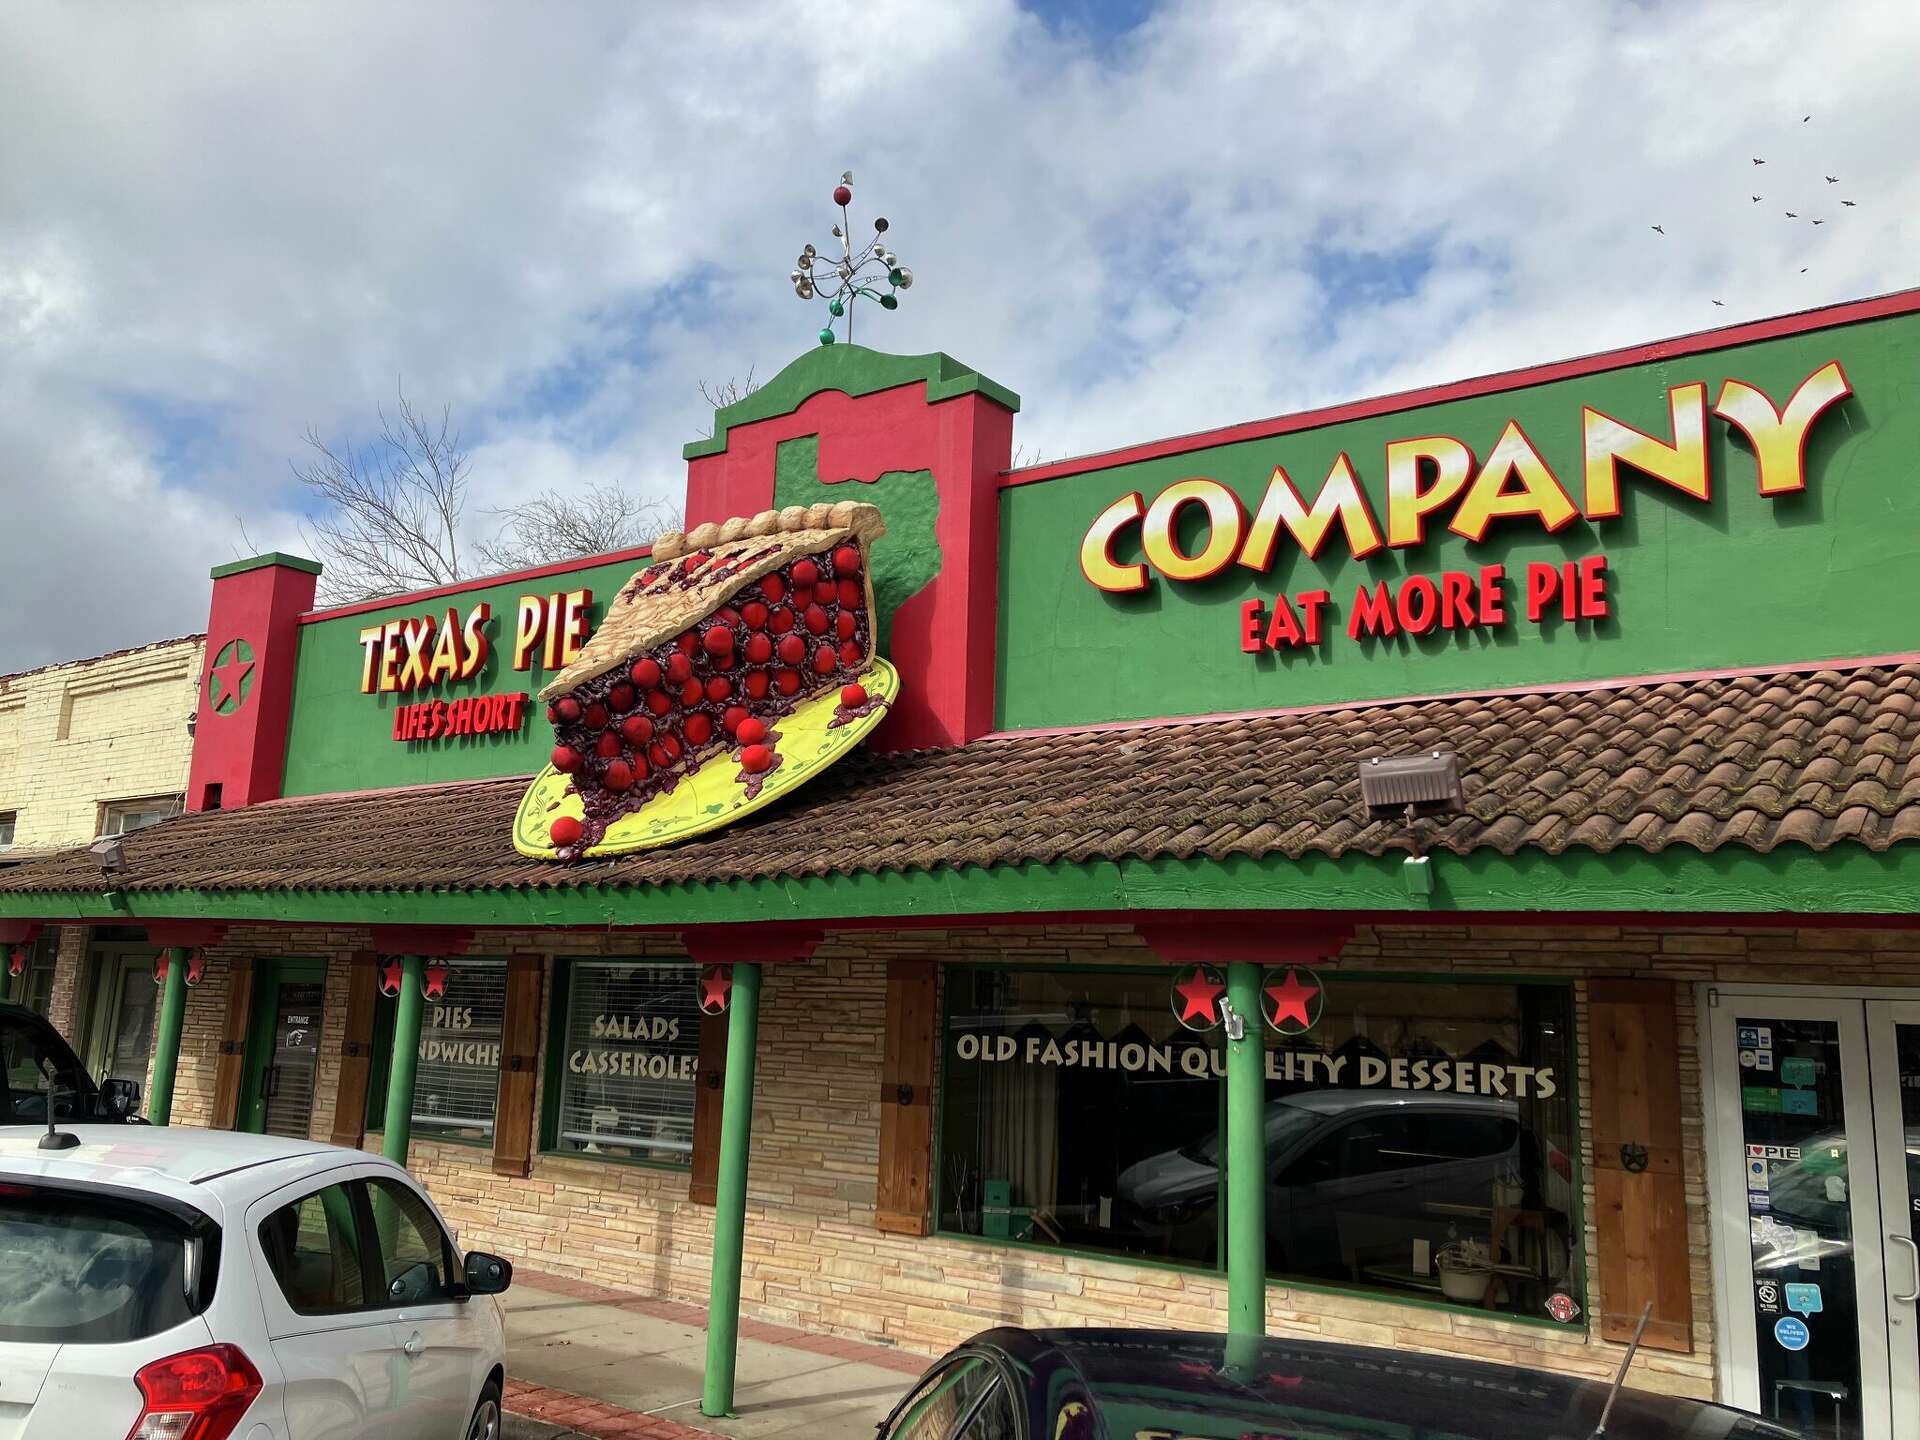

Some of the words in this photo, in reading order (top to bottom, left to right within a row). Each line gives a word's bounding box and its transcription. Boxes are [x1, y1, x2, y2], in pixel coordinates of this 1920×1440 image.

[1080, 360, 1852, 592] COMPANY
[1240, 590, 1330, 654] EAT
[1347, 563, 1506, 643] MORE
[1527, 554, 1609, 623] PIE
[360, 603, 490, 693] TEXAS
[512, 588, 593, 671] PIE
[444, 692, 528, 736] SHORT
[287, 1015, 309, 1025] ENTRANCE
[432, 1006, 472, 1029] PIES
[594, 1014, 680, 1041] SALADS
[418, 1040, 500, 1066] NDWICHE
[957, 1034, 1017, 1062] OLD
[1026, 1037, 1172, 1073] FASHION
[1180, 1047, 1347, 1084] QULITY
[1359, 1057, 1556, 1099] DESSERTS
[1765, 1147, 1799, 1159] PIE
